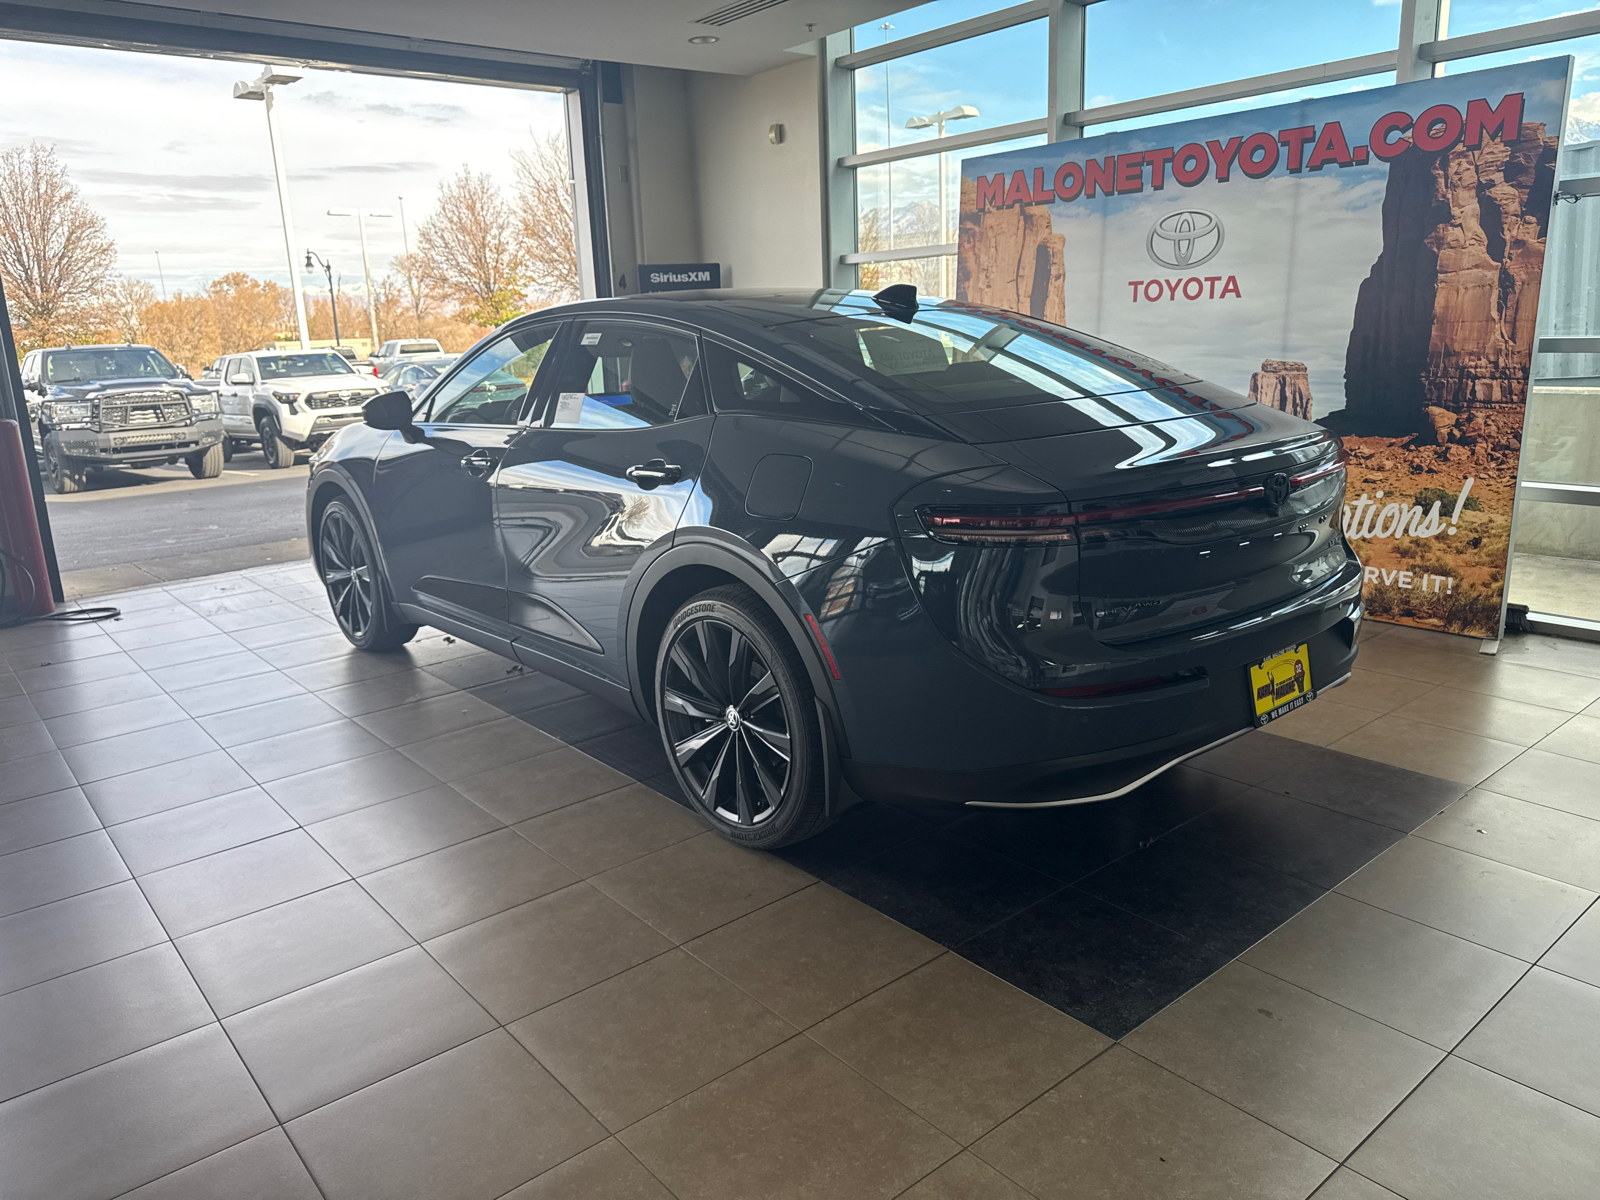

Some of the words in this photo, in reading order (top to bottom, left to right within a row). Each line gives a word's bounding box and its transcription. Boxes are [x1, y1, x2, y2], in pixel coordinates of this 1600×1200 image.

[976, 92, 1525, 210] MALONETOYOTA.COM
[618, 273, 627, 290] 4
[650, 271, 711, 284] SiriusXM
[1128, 275, 1242, 303] TOYOTA
[1421, 574, 1454, 595] IT!
[672, 603, 717, 631] BRIDGESTONE
[1271, 711, 1278, 720] WE
[1279, 704, 1290, 715] MAKE
[1294, 697, 1304, 708] EASY
